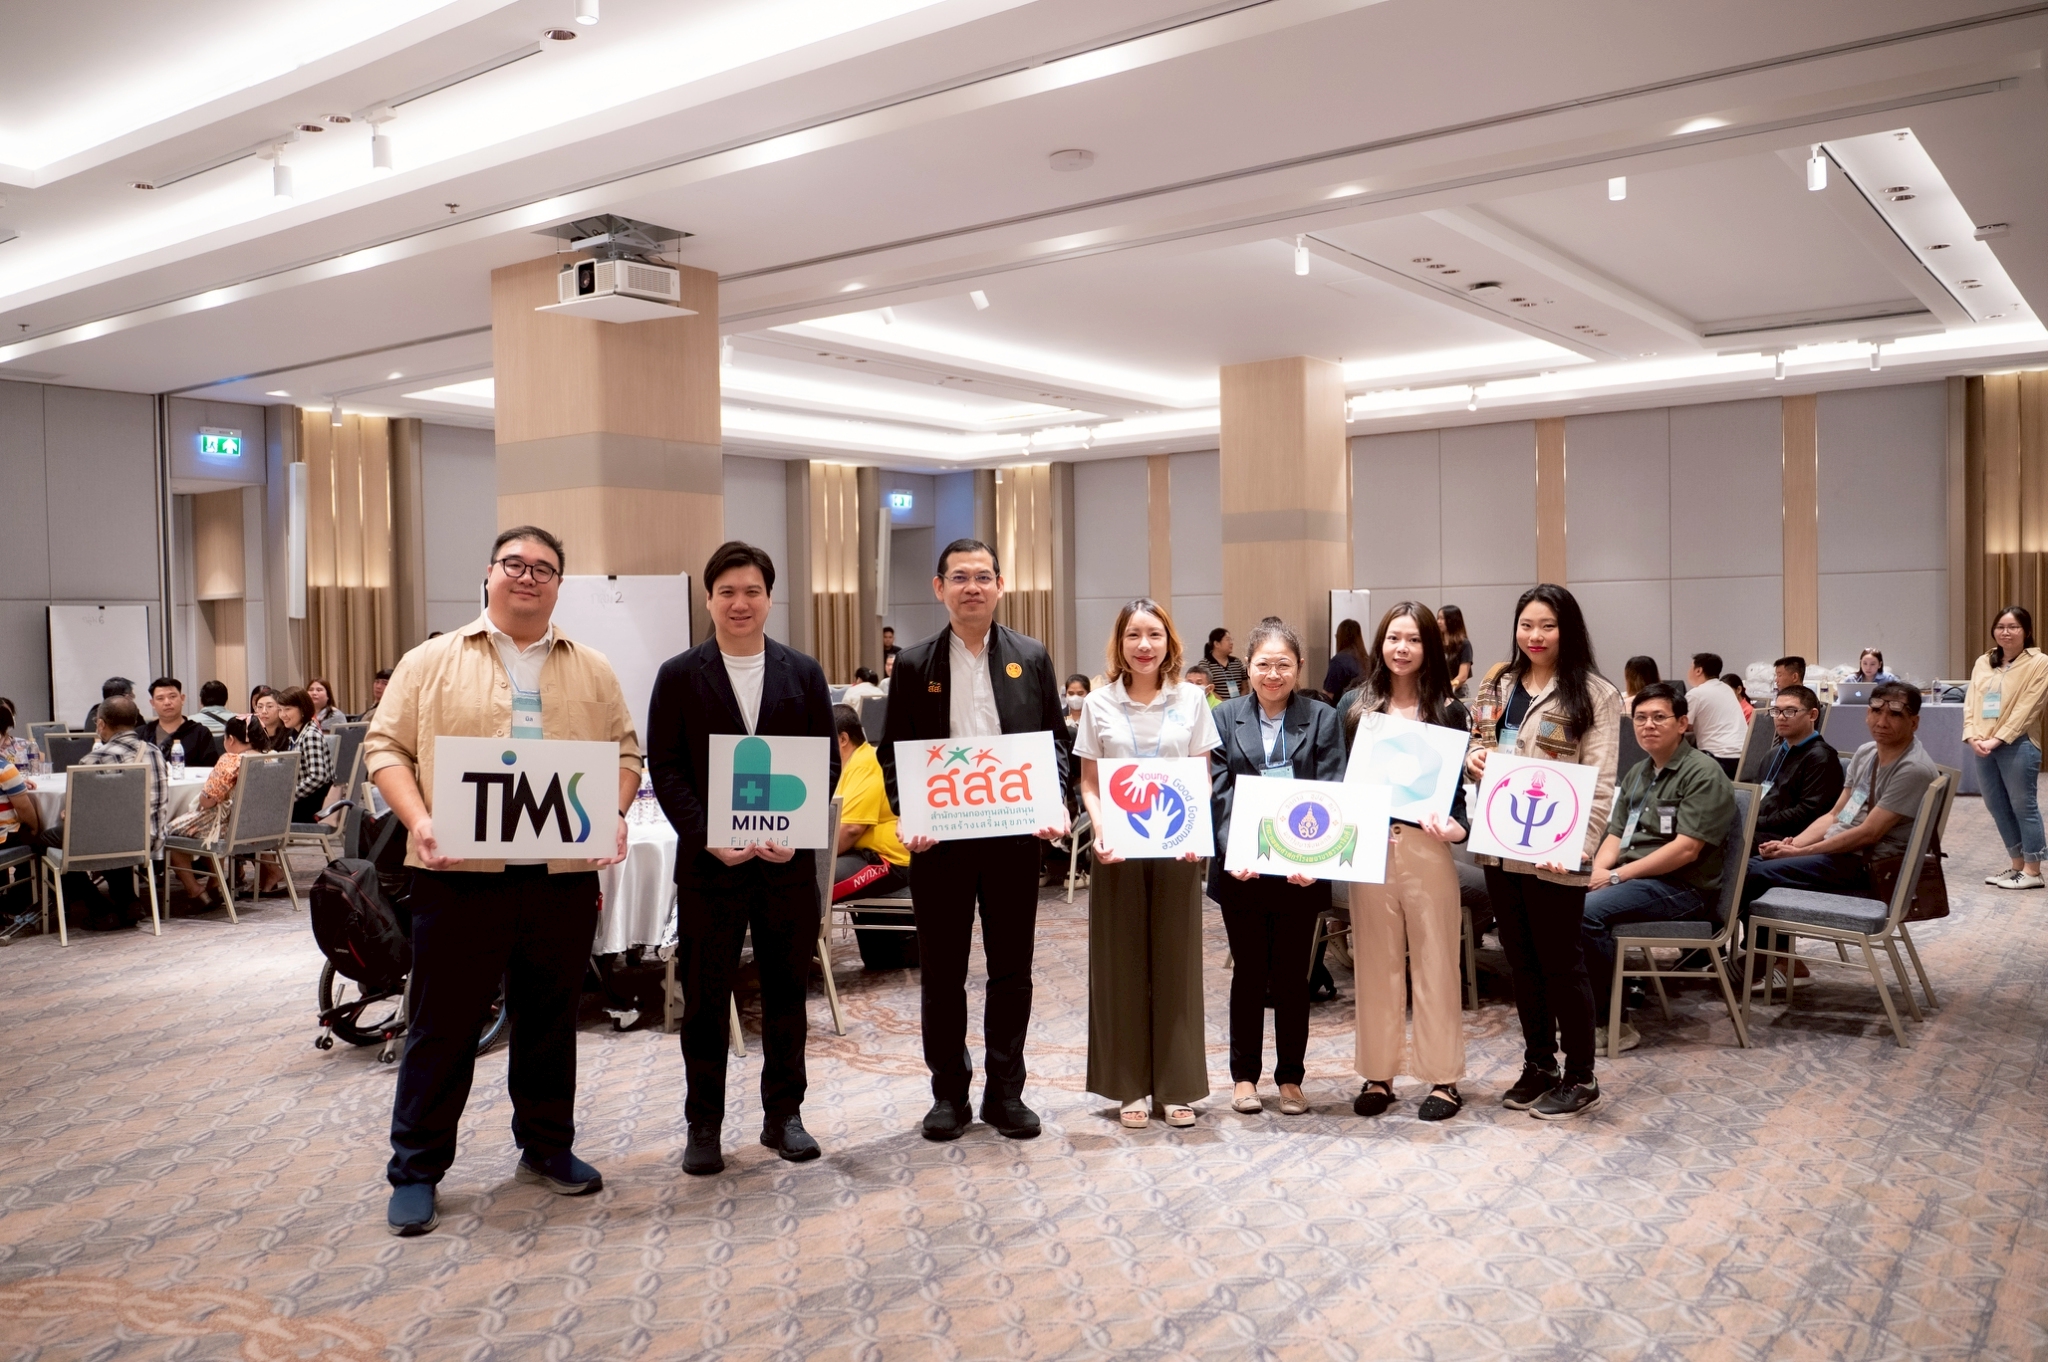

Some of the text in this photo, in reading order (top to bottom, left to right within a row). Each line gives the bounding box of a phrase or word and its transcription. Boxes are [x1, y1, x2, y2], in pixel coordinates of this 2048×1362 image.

[615, 591, 625, 604] 2
[927, 763, 1032, 808] สสส
[930, 806, 1034, 820] สำนักงานกองทุนสนับสนุน
[1138, 772, 1198, 850] Young Good Governance
[732, 815, 790, 831] MIND
[932, 817, 1036, 832] การสร้างเสริมสุขภาพ
